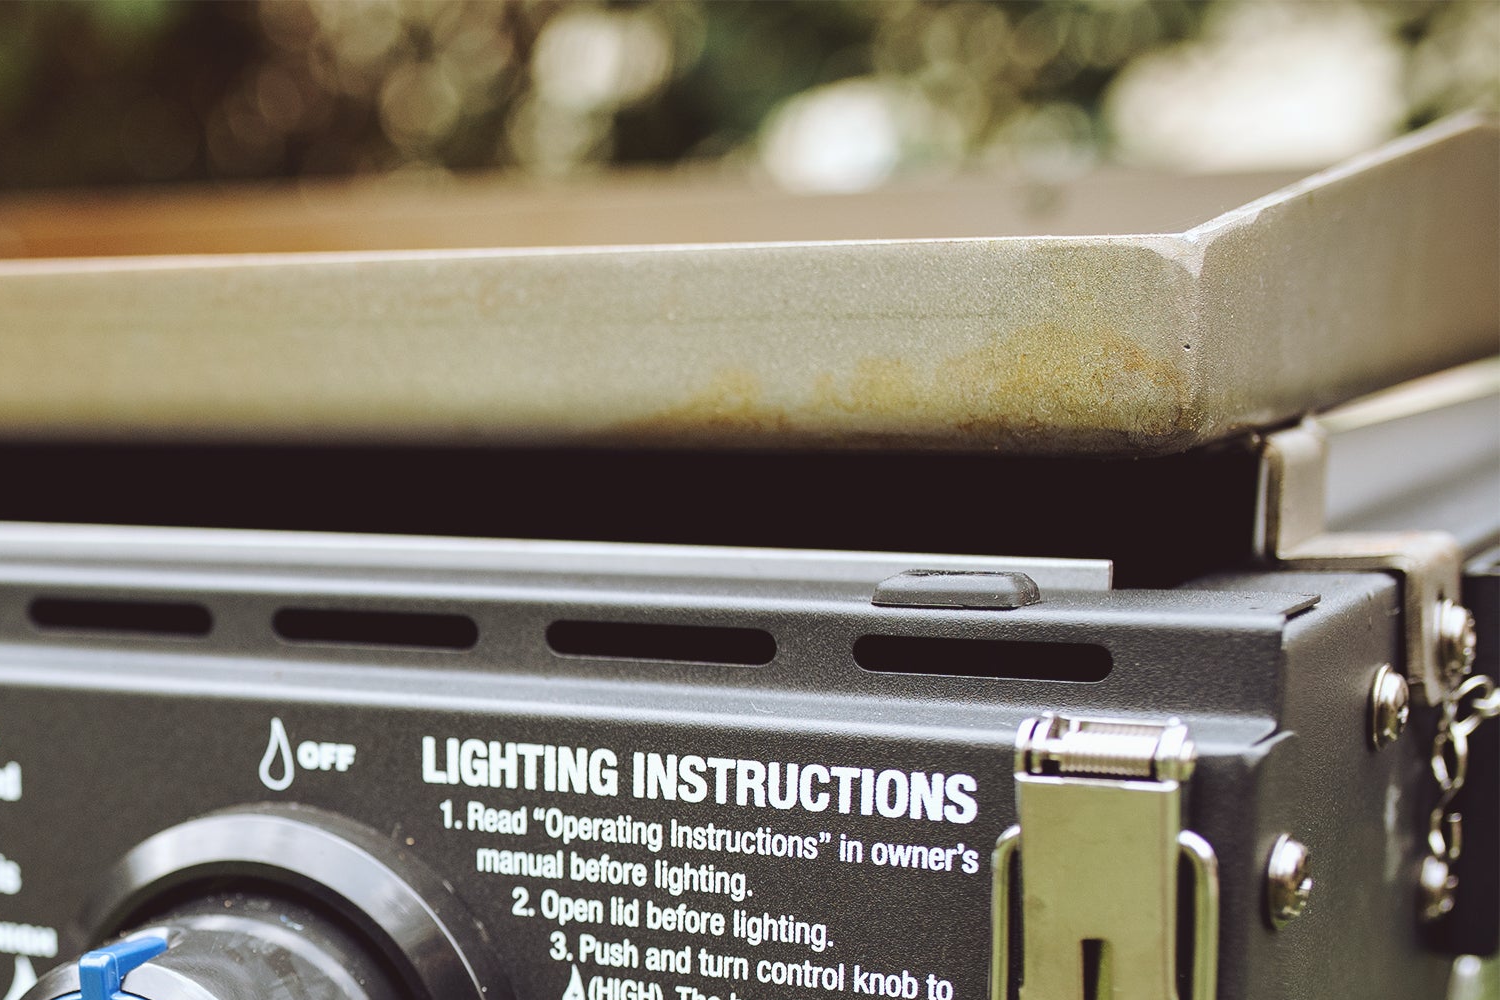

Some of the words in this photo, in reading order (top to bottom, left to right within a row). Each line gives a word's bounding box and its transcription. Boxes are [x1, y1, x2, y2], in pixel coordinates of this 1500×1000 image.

[297, 741, 356, 771] OFF
[421, 735, 619, 797] LIGHTING
[632, 751, 978, 825] INSTRUCTIONS
[439, 798, 463, 830] 1.
[466, 800, 528, 836] Read
[839, 833, 864, 864] in
[870, 842, 980, 874] owner’s
[476, 847, 564, 880] manual
[569, 851, 648, 888] before
[654, 859, 754, 903] lighting.
[511, 886, 536, 918] 2.
[540, 888, 604, 927] Open
[610, 895, 640, 928] lid
[646, 899, 726, 937] before
[732, 909, 834, 953] lighting.
[549, 930, 574, 962] 3.
[579, 933, 639, 969] Push
[644, 945, 692, 975] and
[698, 947, 750, 981] turn
[756, 959, 845, 992] control
[852, 964, 919, 1000] knob
